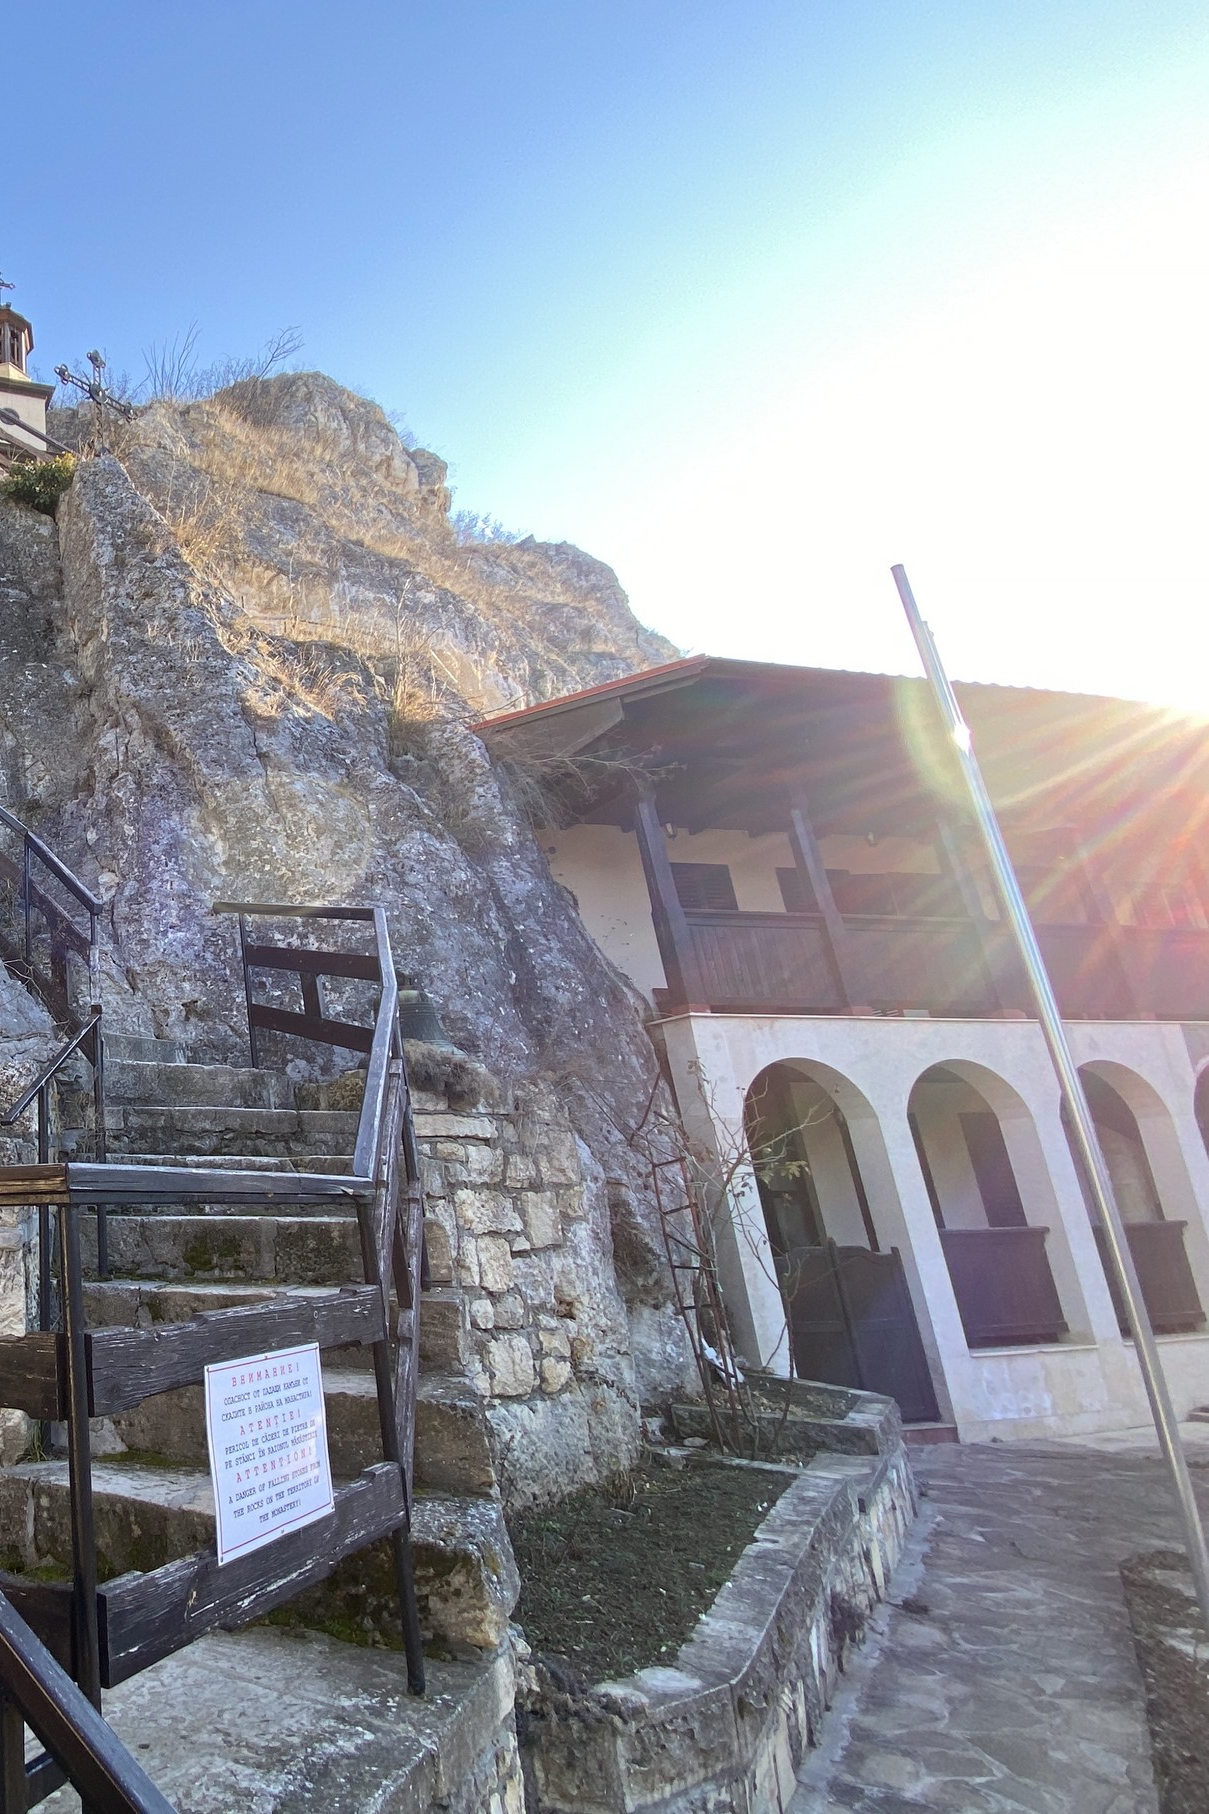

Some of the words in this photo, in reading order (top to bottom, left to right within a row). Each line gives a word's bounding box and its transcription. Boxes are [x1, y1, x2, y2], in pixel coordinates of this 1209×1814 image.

[224, 1392, 251, 1406] ОПАСНОСТ
[252, 1389, 260, 1399] ОТ
[302, 1377, 309, 1385] ОТ
[221, 1408, 246, 1422] СКАЛИТЕ
[248, 1406, 252, 1415] В
[254, 1401, 275, 1413] РАЙОНА
[276, 1398, 283, 1407] НА
[225, 1441, 250, 1455] PERICOL
[252, 1438, 259, 1446] DE
[282, 1428, 289, 1436] DE
[291, 1421, 308, 1434] PIETRE
[309, 1419, 316, 1427] DE
[225, 1460, 233, 1469] PE
[235, 1452, 256, 1466] STÂNCI
[258, 1447, 265, 1458] ÎN
[267, 1441, 289, 1454] RAIONUL
[229, 1495, 233, 1504] A
[235, 1486, 257, 1501] DANGER
[258, 1483, 266, 1492] OF
[268, 1473, 290, 1489] FALLING
[292, 1466, 308, 1479] STONES
[310, 1461, 321, 1471] FROM
[233, 1507, 245, 1518] THE
[247, 1499, 264, 1513] ROCKS
[266, 1495, 273, 1505] ON
[275, 1490, 285, 1500] THE
[287, 1479, 312, 1496] TERRITORY
[313, 1475, 320, 1484] OF
[259, 1512, 269, 1523] THE
[271, 1498, 301, 1518] MONASTERY!
